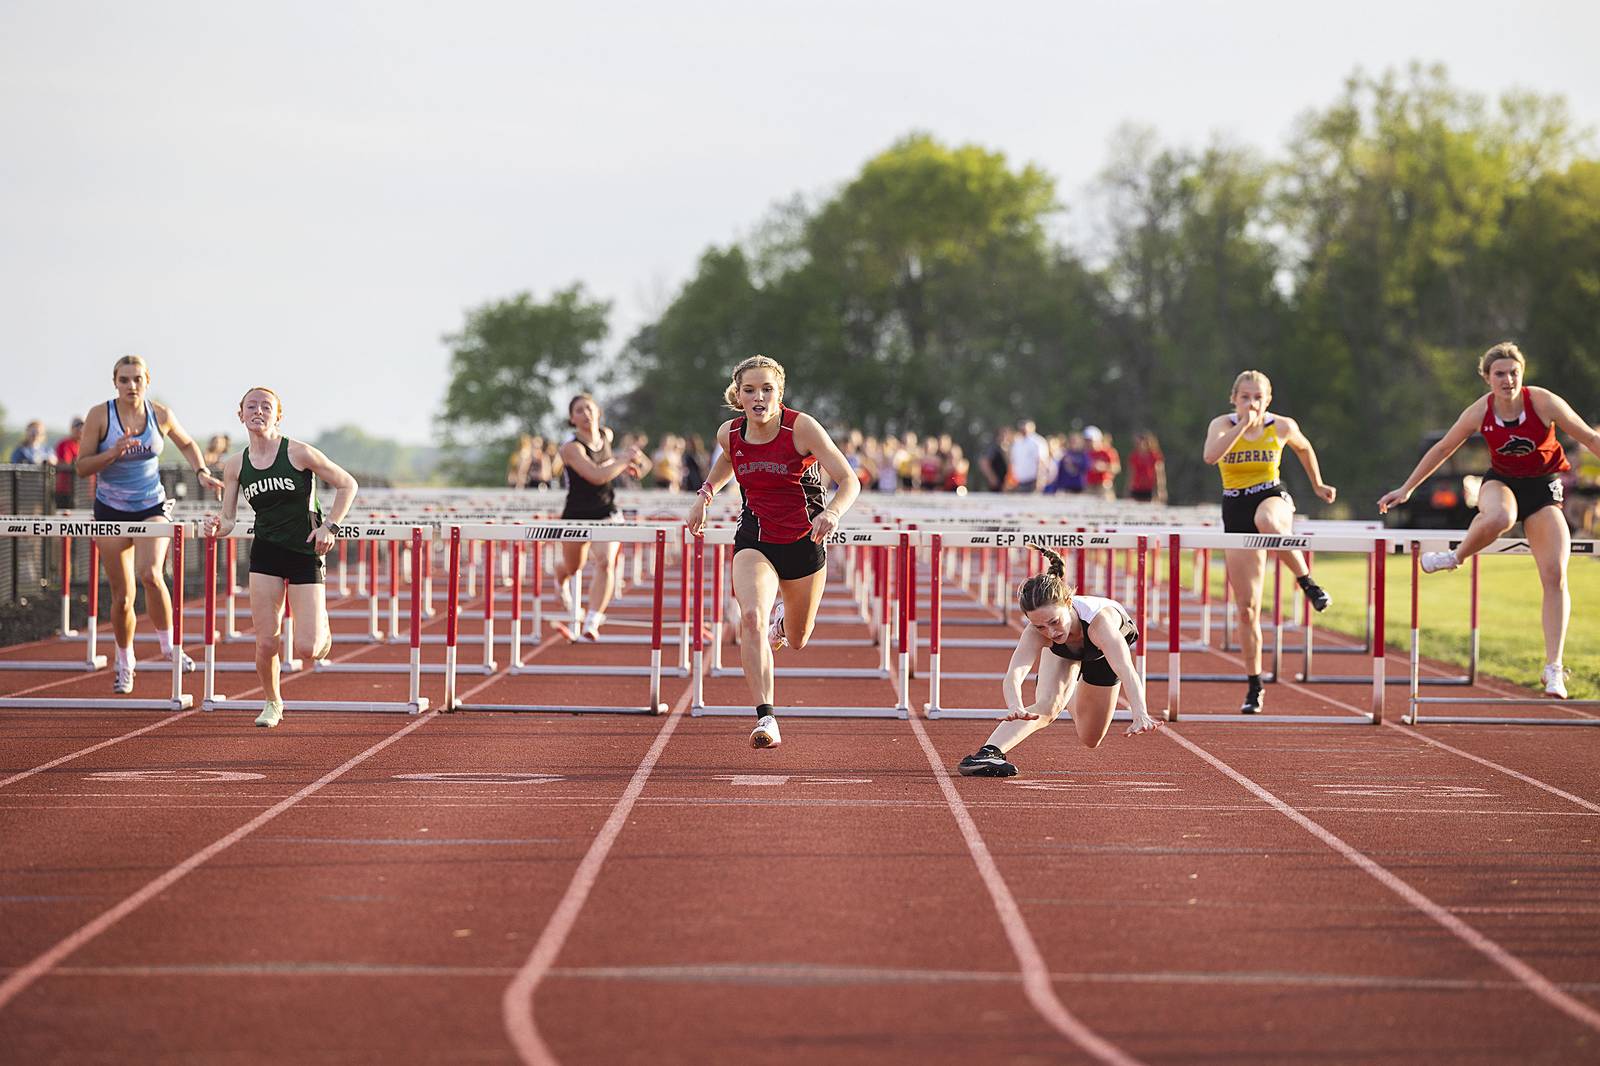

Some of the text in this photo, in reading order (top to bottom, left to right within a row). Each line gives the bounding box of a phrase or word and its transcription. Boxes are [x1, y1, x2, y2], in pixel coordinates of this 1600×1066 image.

[125, 445, 152, 456] TORM
[738, 462, 789, 475] CLIPPERS
[244, 477, 296, 501] BRUINS
[33, 523, 52, 535] E-P
[60, 523, 121, 535] PANTHERS
[563, 529, 589, 538] GILL
[996, 535, 1015, 546] E-P
[1023, 535, 1084, 546] PANTHERS
[1282, 539, 1307, 547] GILL
